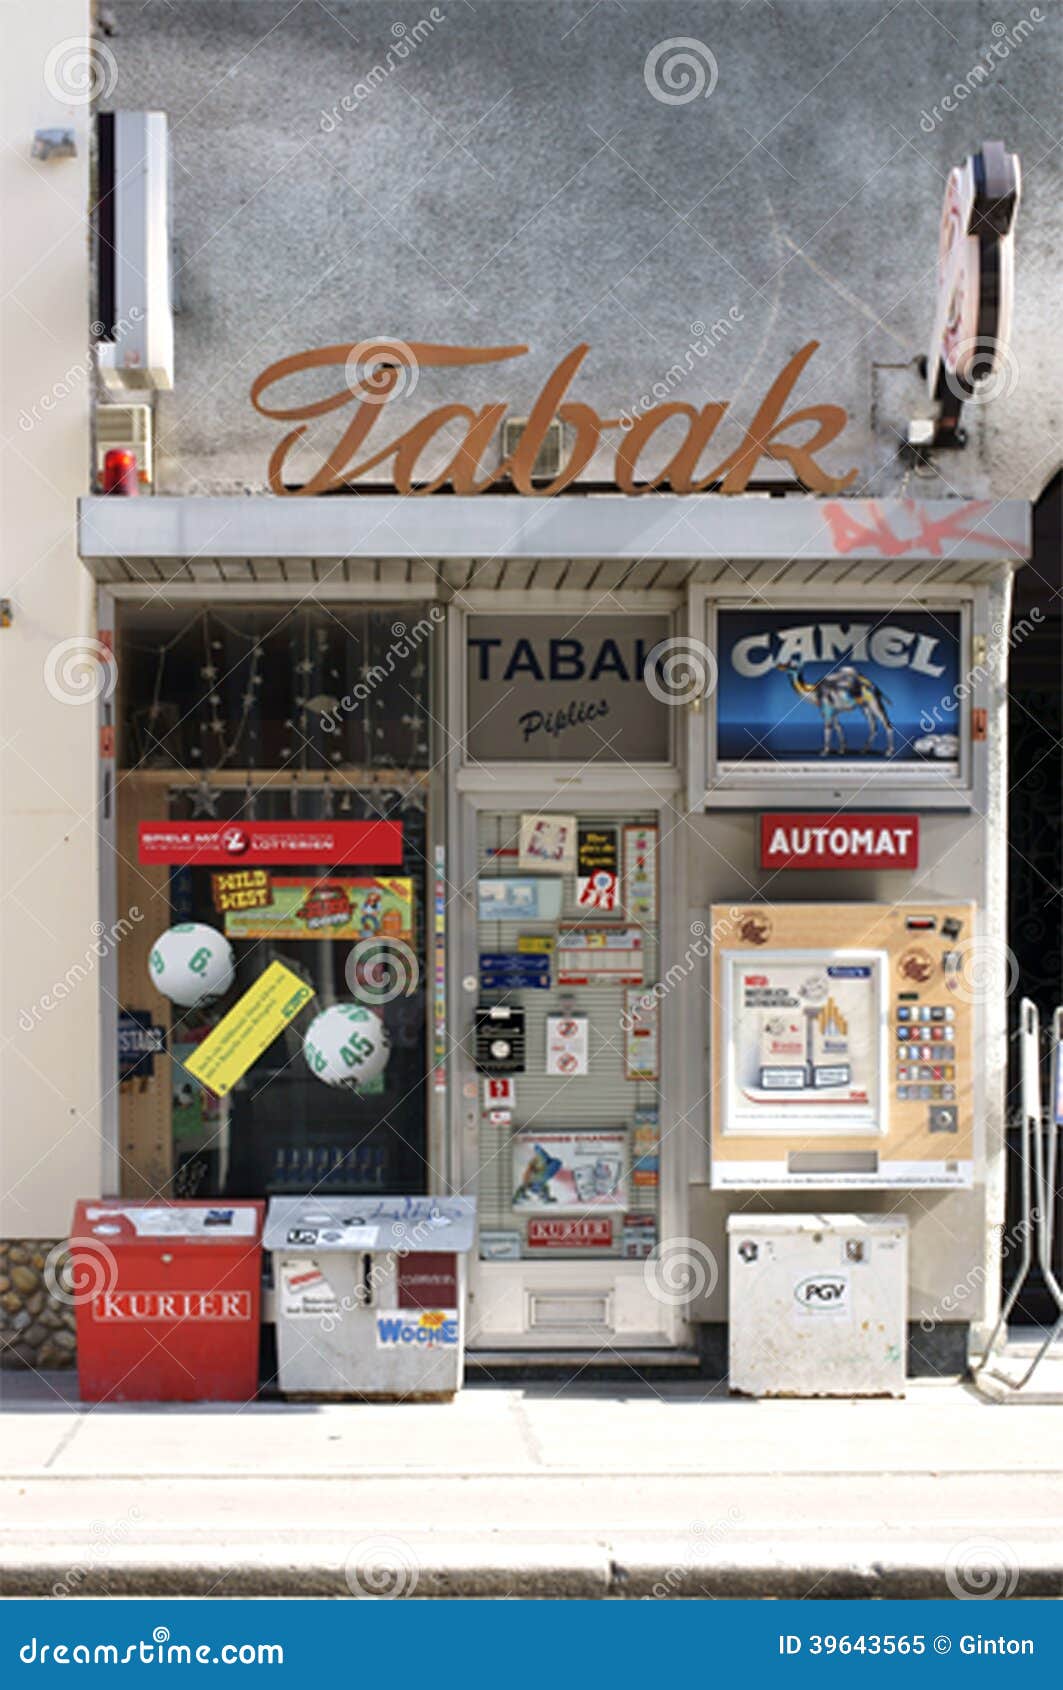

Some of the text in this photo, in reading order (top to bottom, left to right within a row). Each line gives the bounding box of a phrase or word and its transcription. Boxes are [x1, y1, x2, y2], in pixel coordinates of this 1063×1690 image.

[250, 340, 858, 496] Tabak
[731, 623, 946, 679] CAMEL
[768, 828, 912, 856] AUTOMAT
[218, 871, 267, 891] WILD
[221, 889, 268, 910] WEST
[339, 1031, 375, 1068] 45
[806, 1284, 845, 1301] PGV
[104, 1294, 241, 1317] KURIER
